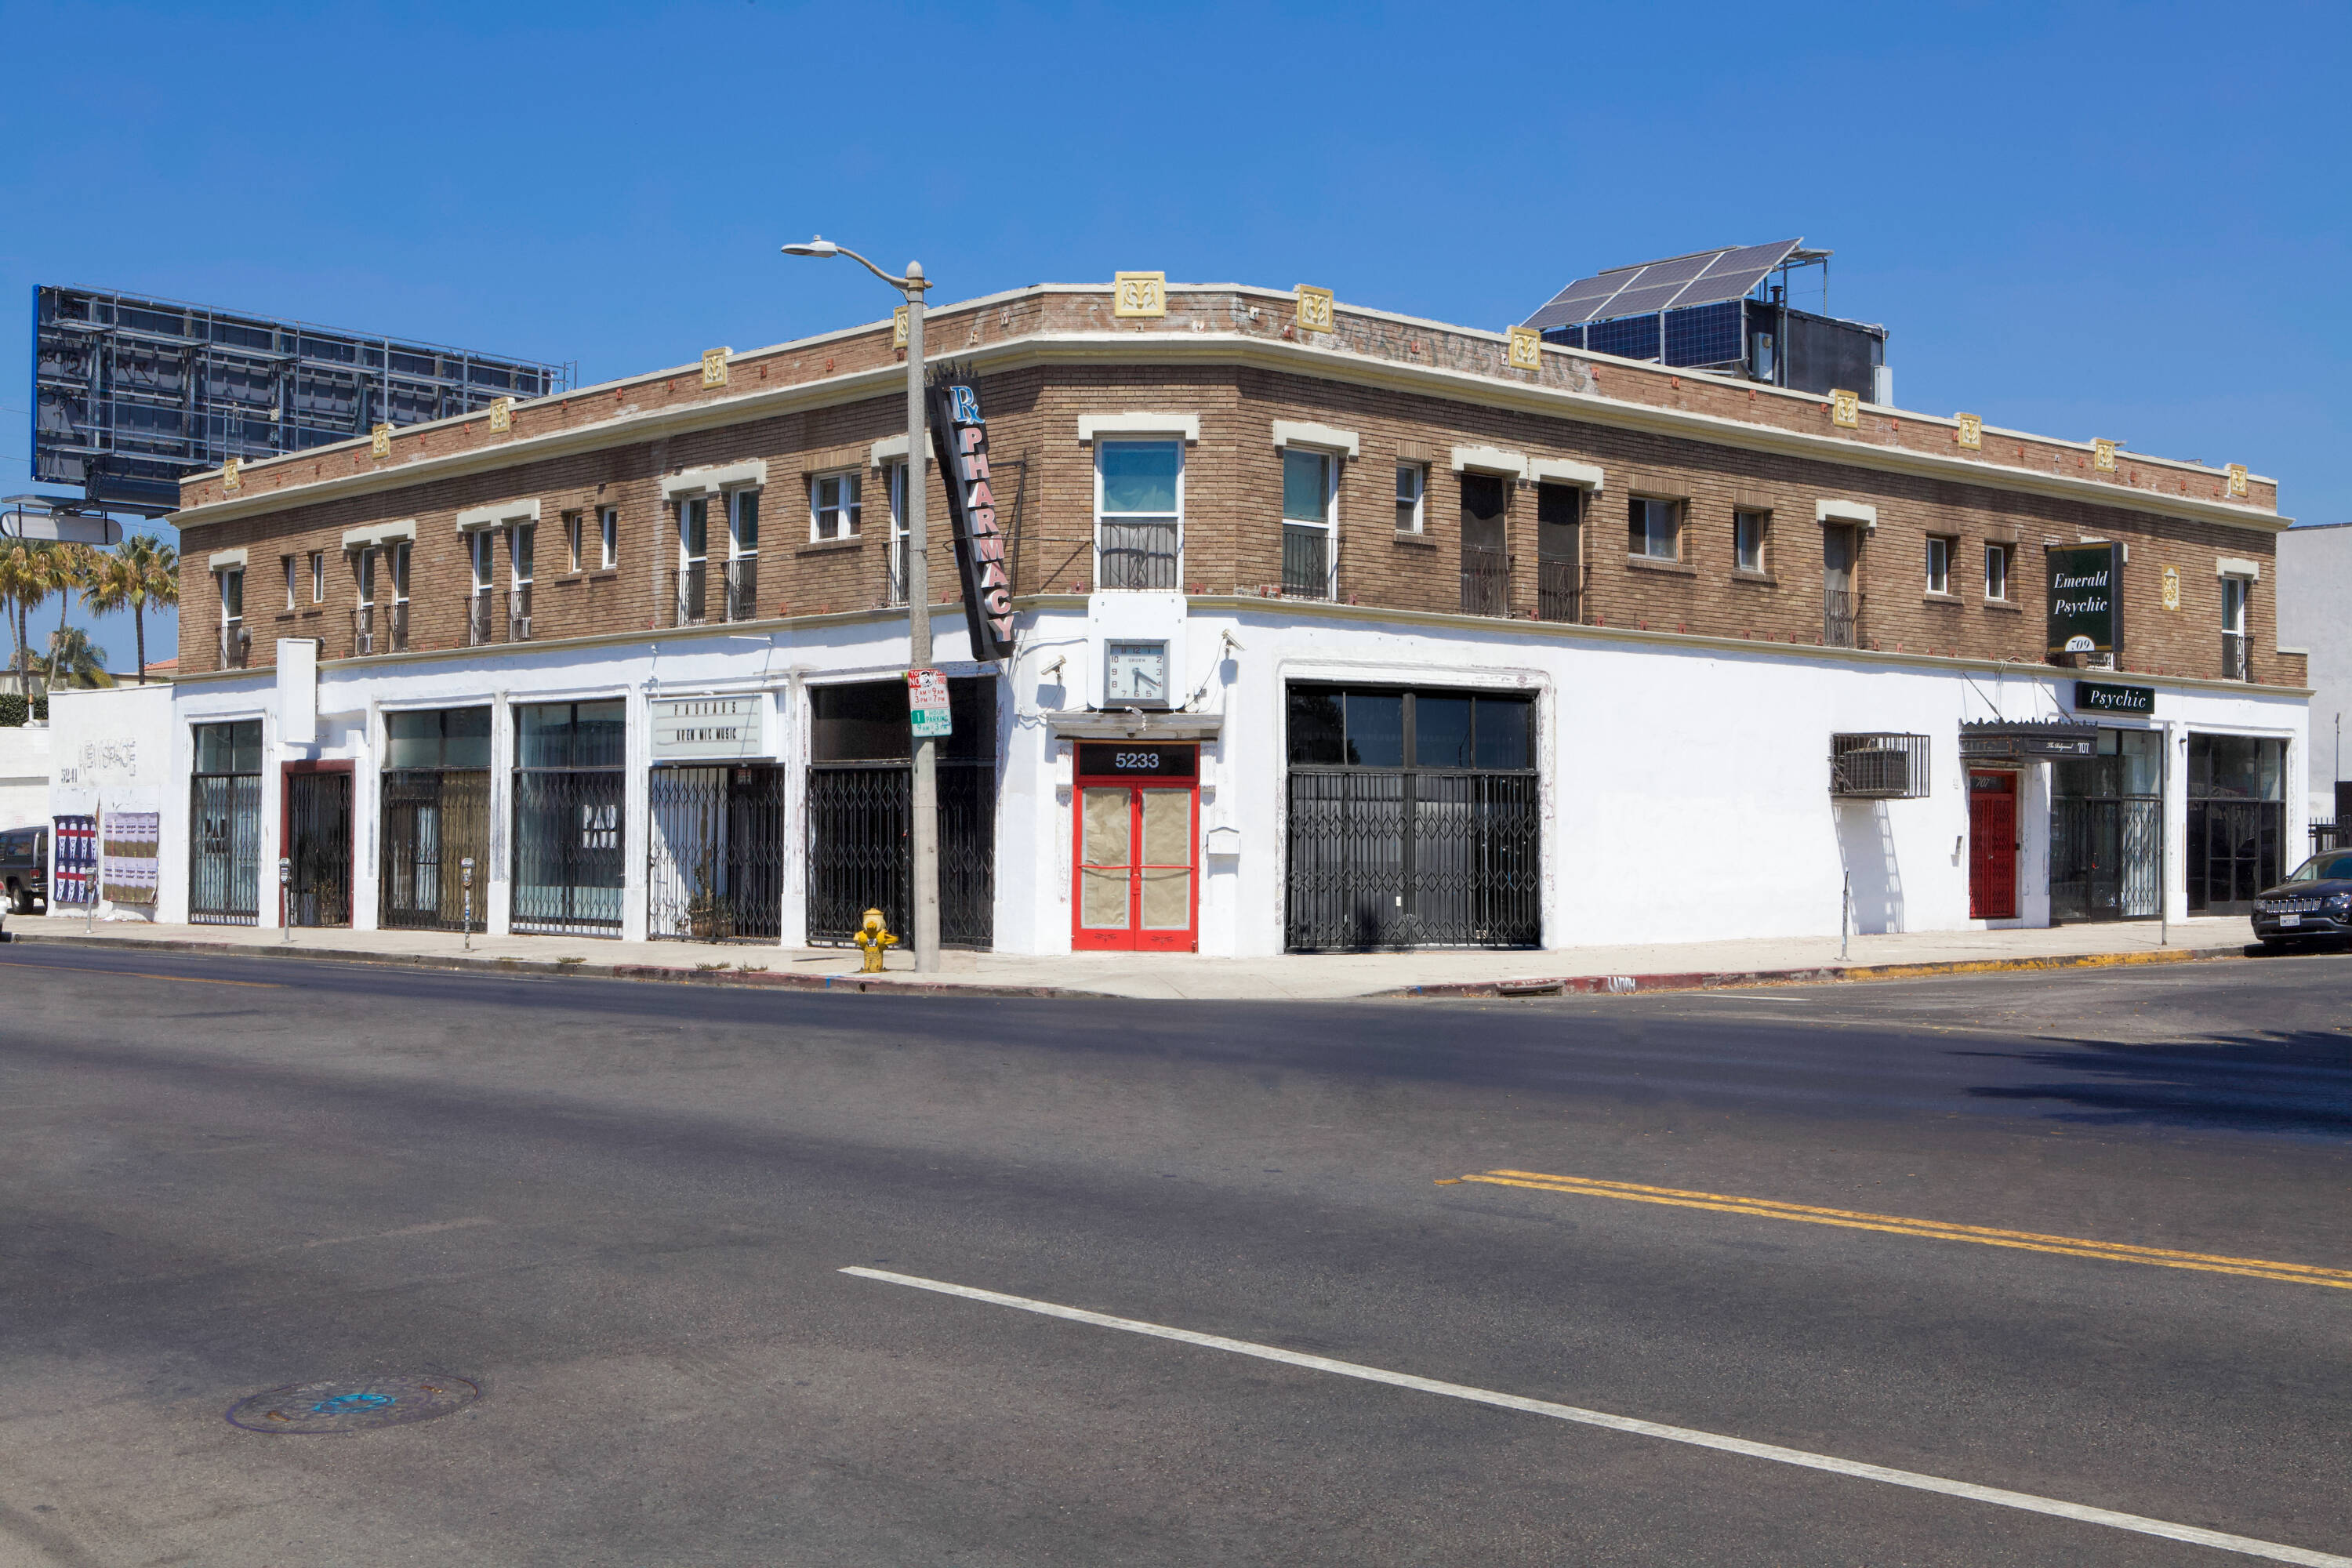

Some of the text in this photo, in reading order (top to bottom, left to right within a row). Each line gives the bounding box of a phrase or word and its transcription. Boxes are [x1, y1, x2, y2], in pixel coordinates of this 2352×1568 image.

[961, 427, 1014, 642] PHARMACY
[2054, 571, 2108, 589] Emerald
[2054, 596, 2108, 618] Psychic
[2091, 690, 2146, 708] Psychic
[674, 701, 736, 716] PAUHAUS
[916, 712, 920, 722] 1
[677, 728, 736, 741] OPEN MIC MUSIC
[2078, 742, 2090, 754] 707
[1115, 753, 1160, 768] 5233
[61, 768, 77, 783] 5241
[1976, 777, 1991, 789] 707
